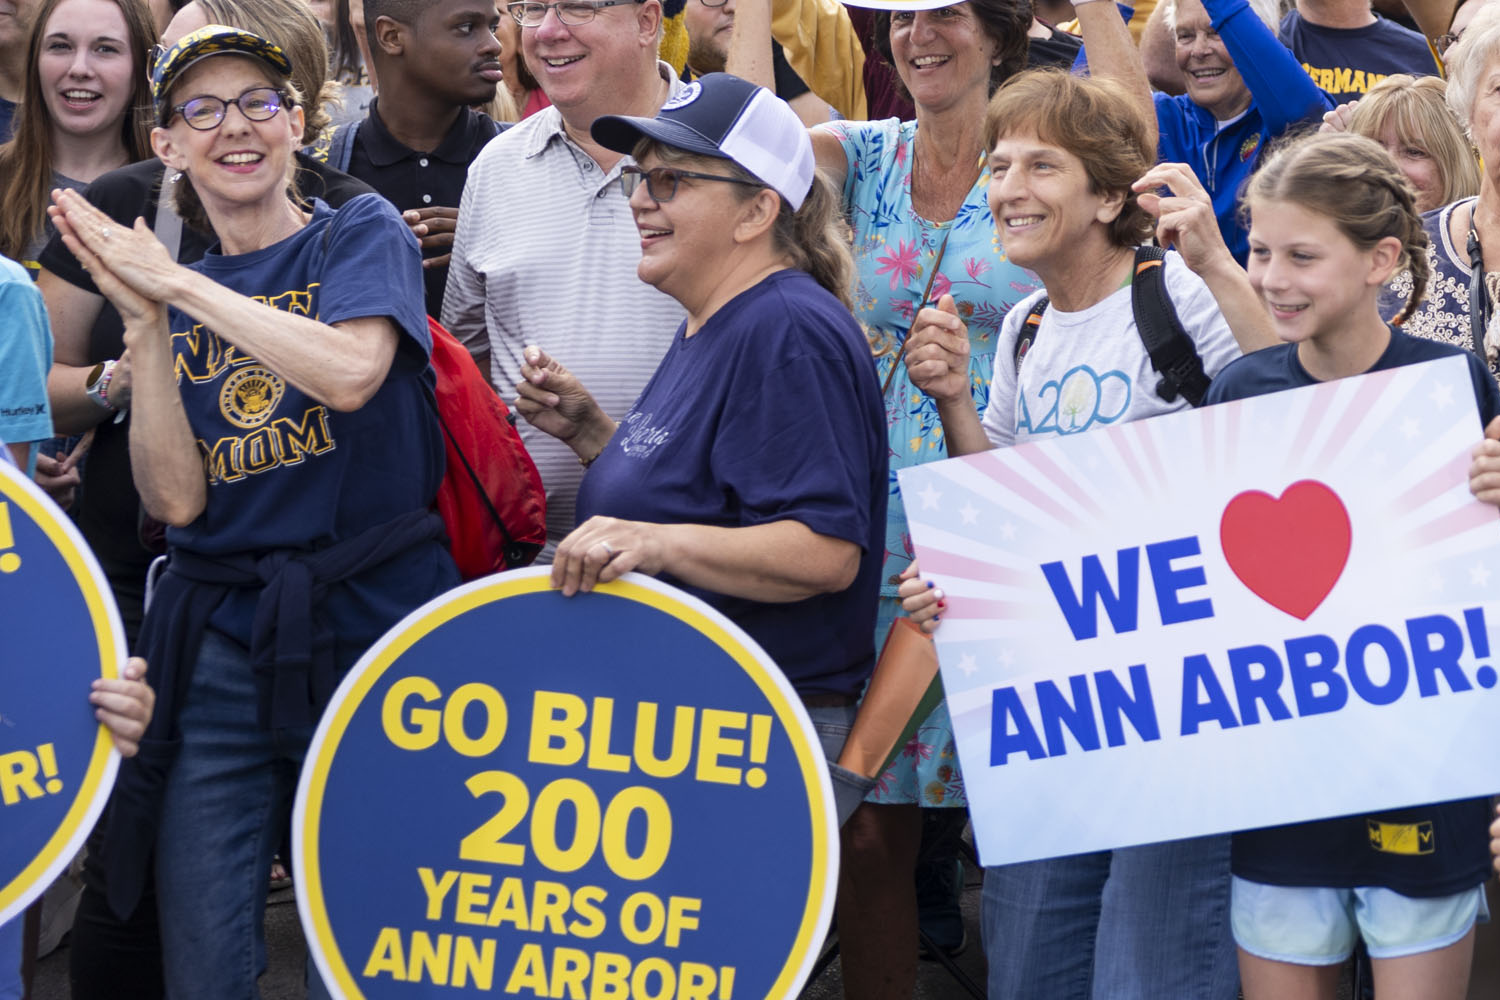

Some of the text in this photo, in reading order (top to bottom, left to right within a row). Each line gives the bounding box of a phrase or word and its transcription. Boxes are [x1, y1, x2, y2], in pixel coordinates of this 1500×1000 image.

[197, 404, 337, 485] MOM
[1015, 364, 1132, 436] A200
[1040, 536, 1214, 641] WE
[381, 676, 773, 789] GO BLUE!
[989, 607, 1498, 767] ANN ARBOR!
[460, 770, 672, 880] 200
[418, 868, 701, 947] YEARS OF
[364, 927, 497, 990] ANN
